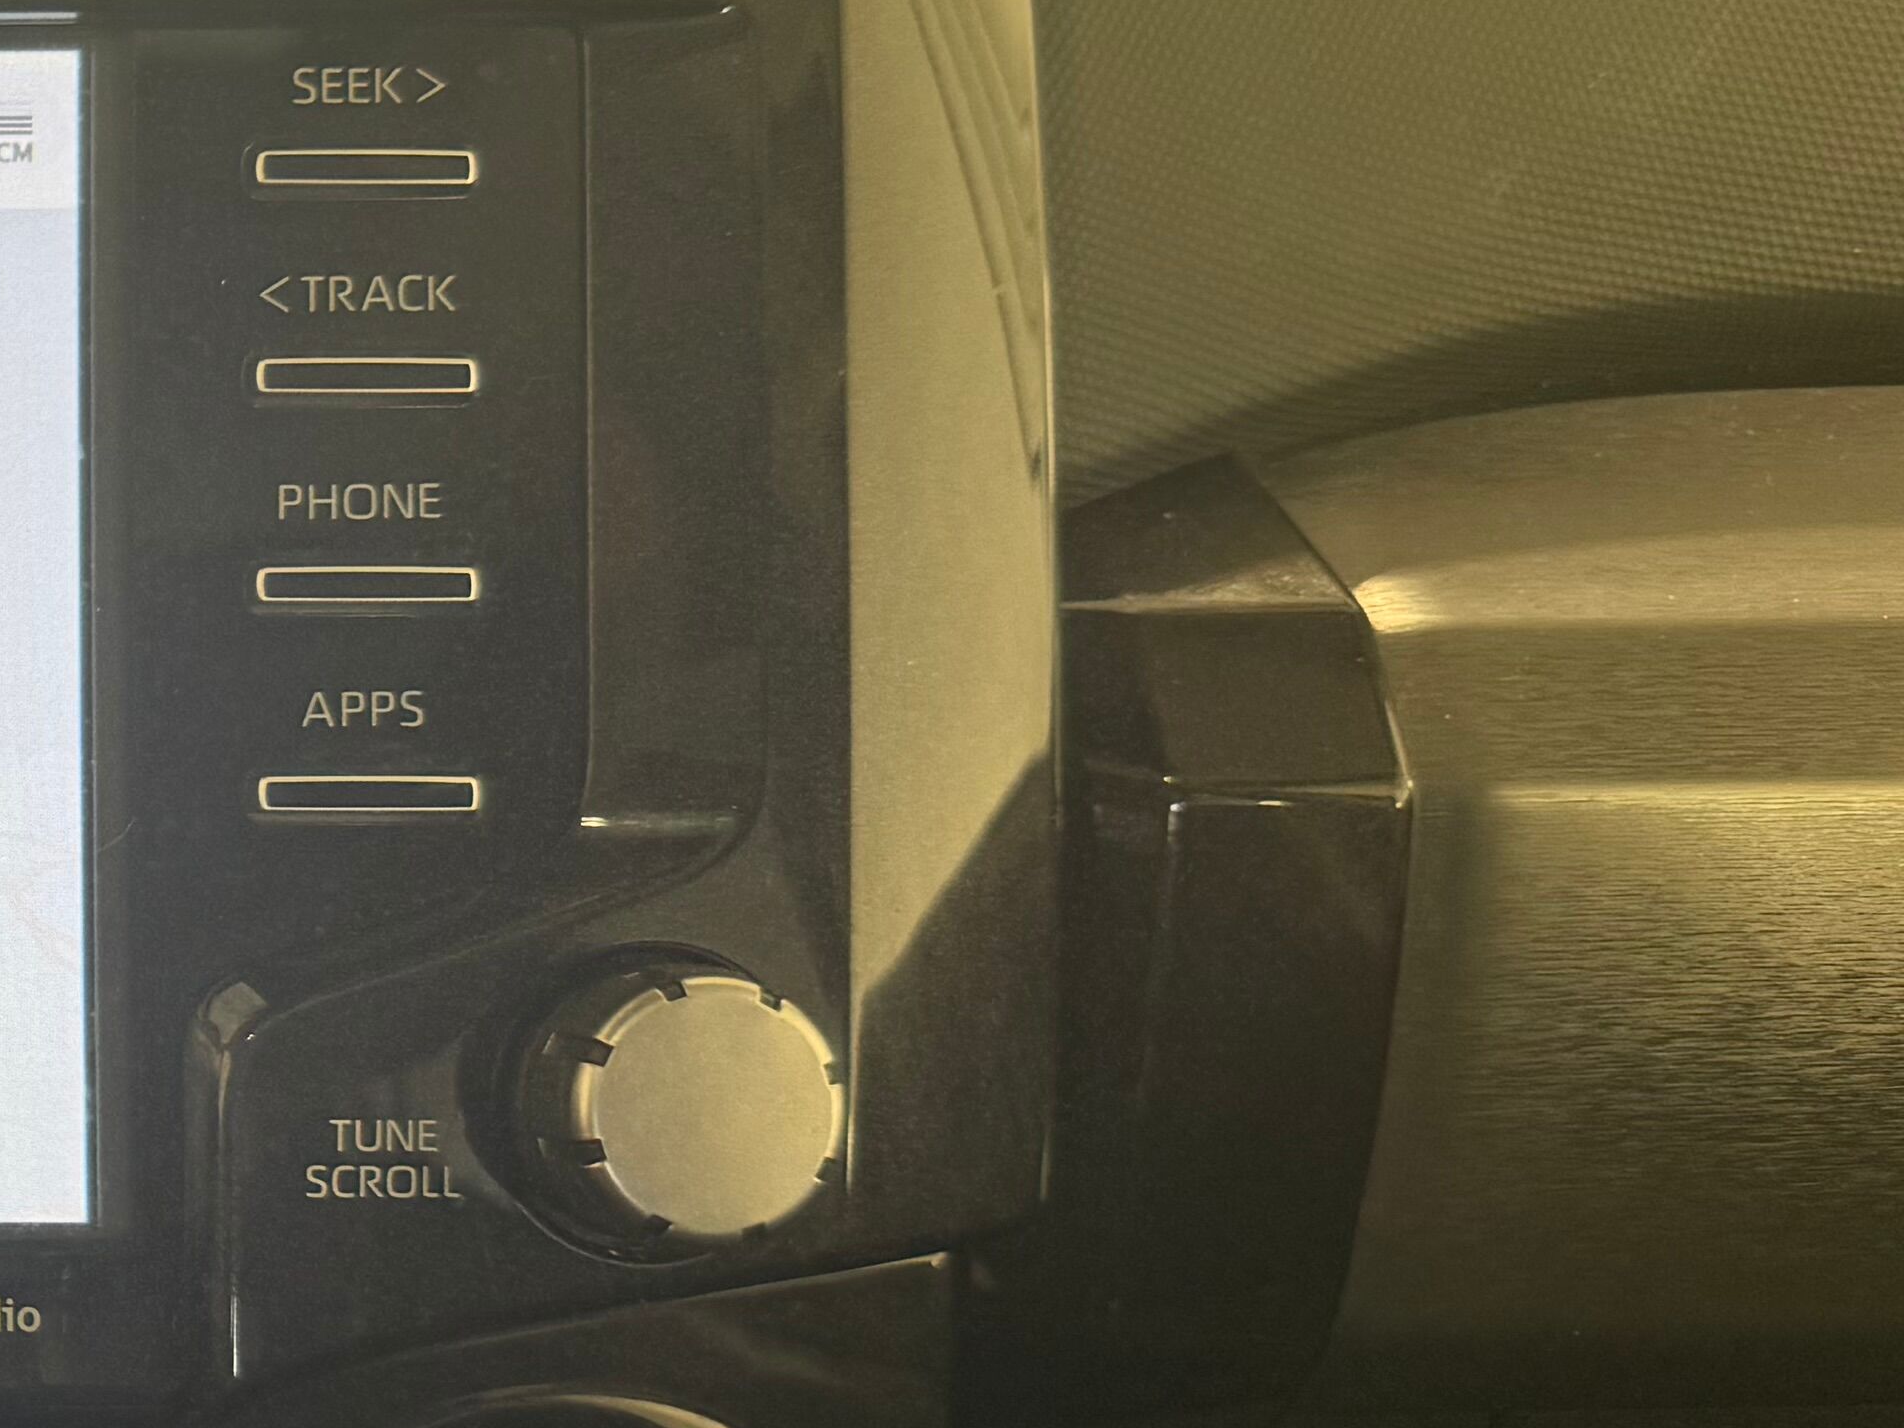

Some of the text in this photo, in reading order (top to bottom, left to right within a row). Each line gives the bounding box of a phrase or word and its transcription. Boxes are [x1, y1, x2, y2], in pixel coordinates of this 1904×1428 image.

[293, 67, 404, 104] SEEK
[301, 275, 457, 312] TRACK
[278, 484, 441, 521] PHONE
[302, 691, 425, 728] APPS
[329, 1118, 439, 1154] TUNE
[305, 1165, 461, 1199] SCROLL
